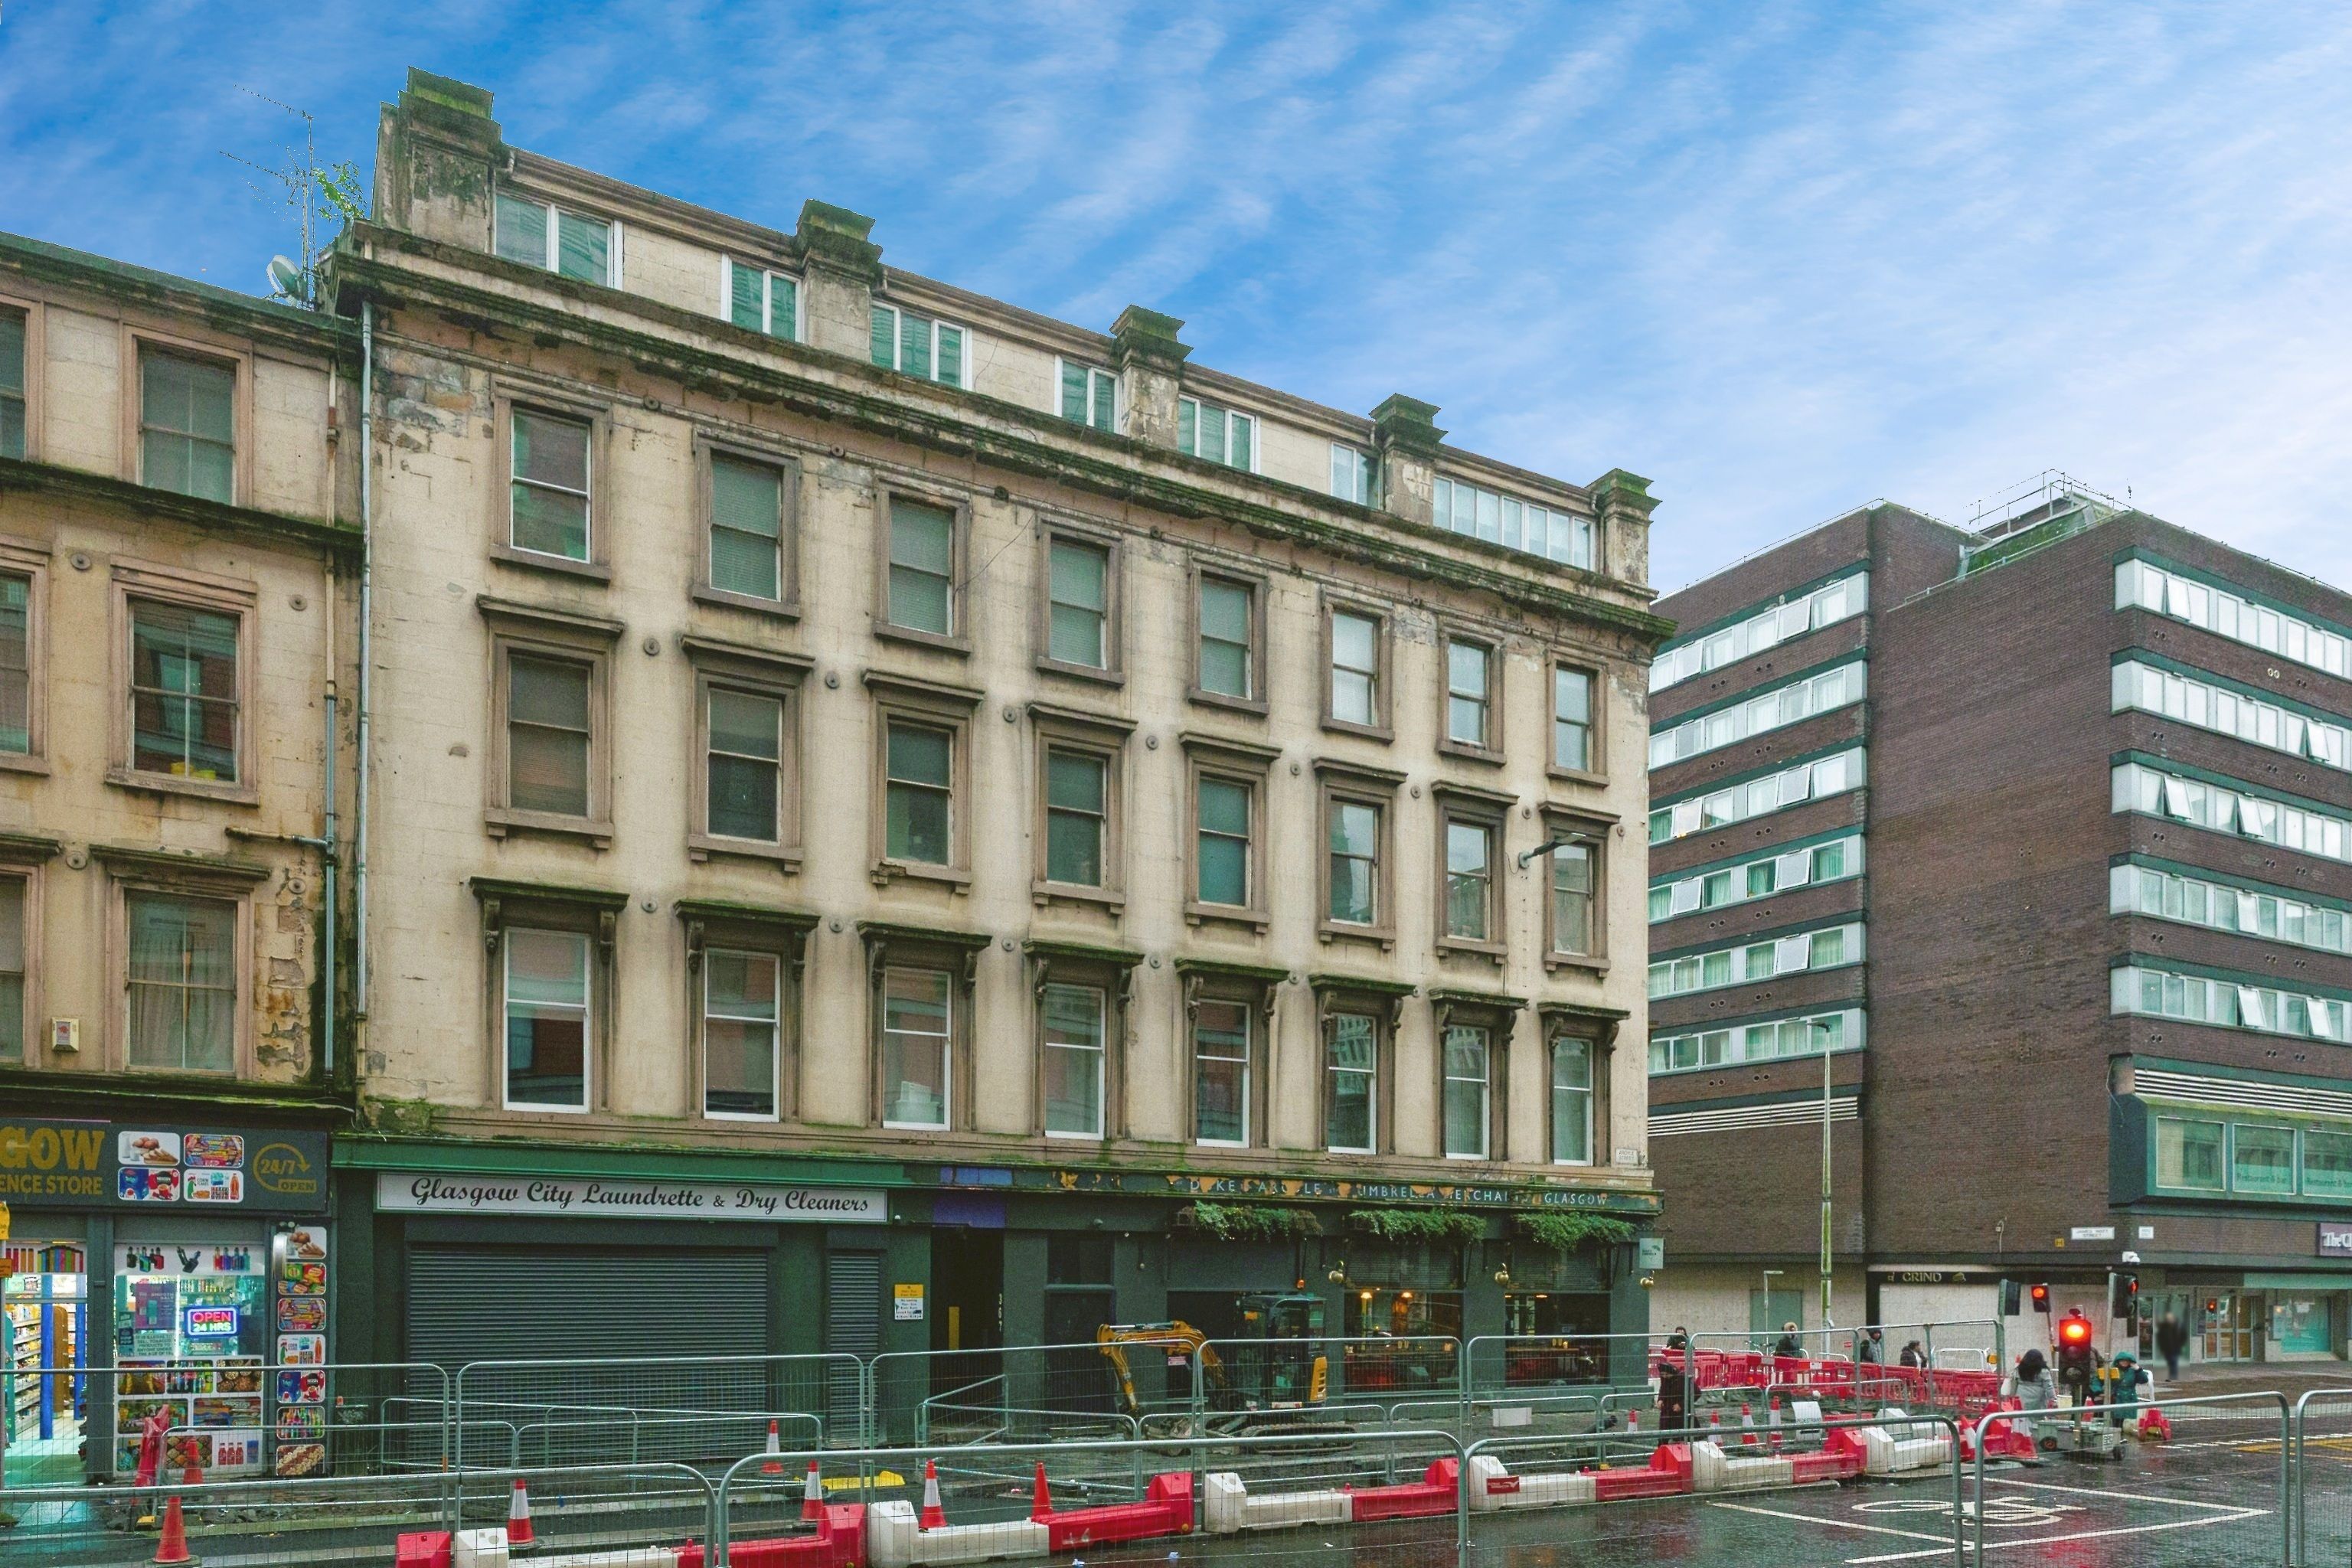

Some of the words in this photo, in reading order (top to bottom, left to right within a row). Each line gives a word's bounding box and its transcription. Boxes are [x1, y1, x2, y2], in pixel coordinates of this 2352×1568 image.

[0, 1126, 105, 1170] GOW
[261, 1158, 296, 1174] 24/7
[47, 1175, 103, 1194] STORE
[281, 1181, 315, 1191] OPEN
[1190, 1180, 1235, 1193] DKE
[1544, 1192, 1607, 1205] GLASGOW
[411, 1178, 519, 1206] Glasgow
[527, 1181, 574, 1209] City
[582, 1184, 703, 1207] Laundrette
[713, 1195, 725, 1207] &
[736, 1189, 779, 1215] Dry
[785, 1191, 868, 1211] Cleaners
[1902, 1272, 1942, 1282] GRIND
[192, 1311, 232, 1323] OPEN
[193, 1322, 207, 1331] 24
[209, 1321, 232, 1331] HRS
